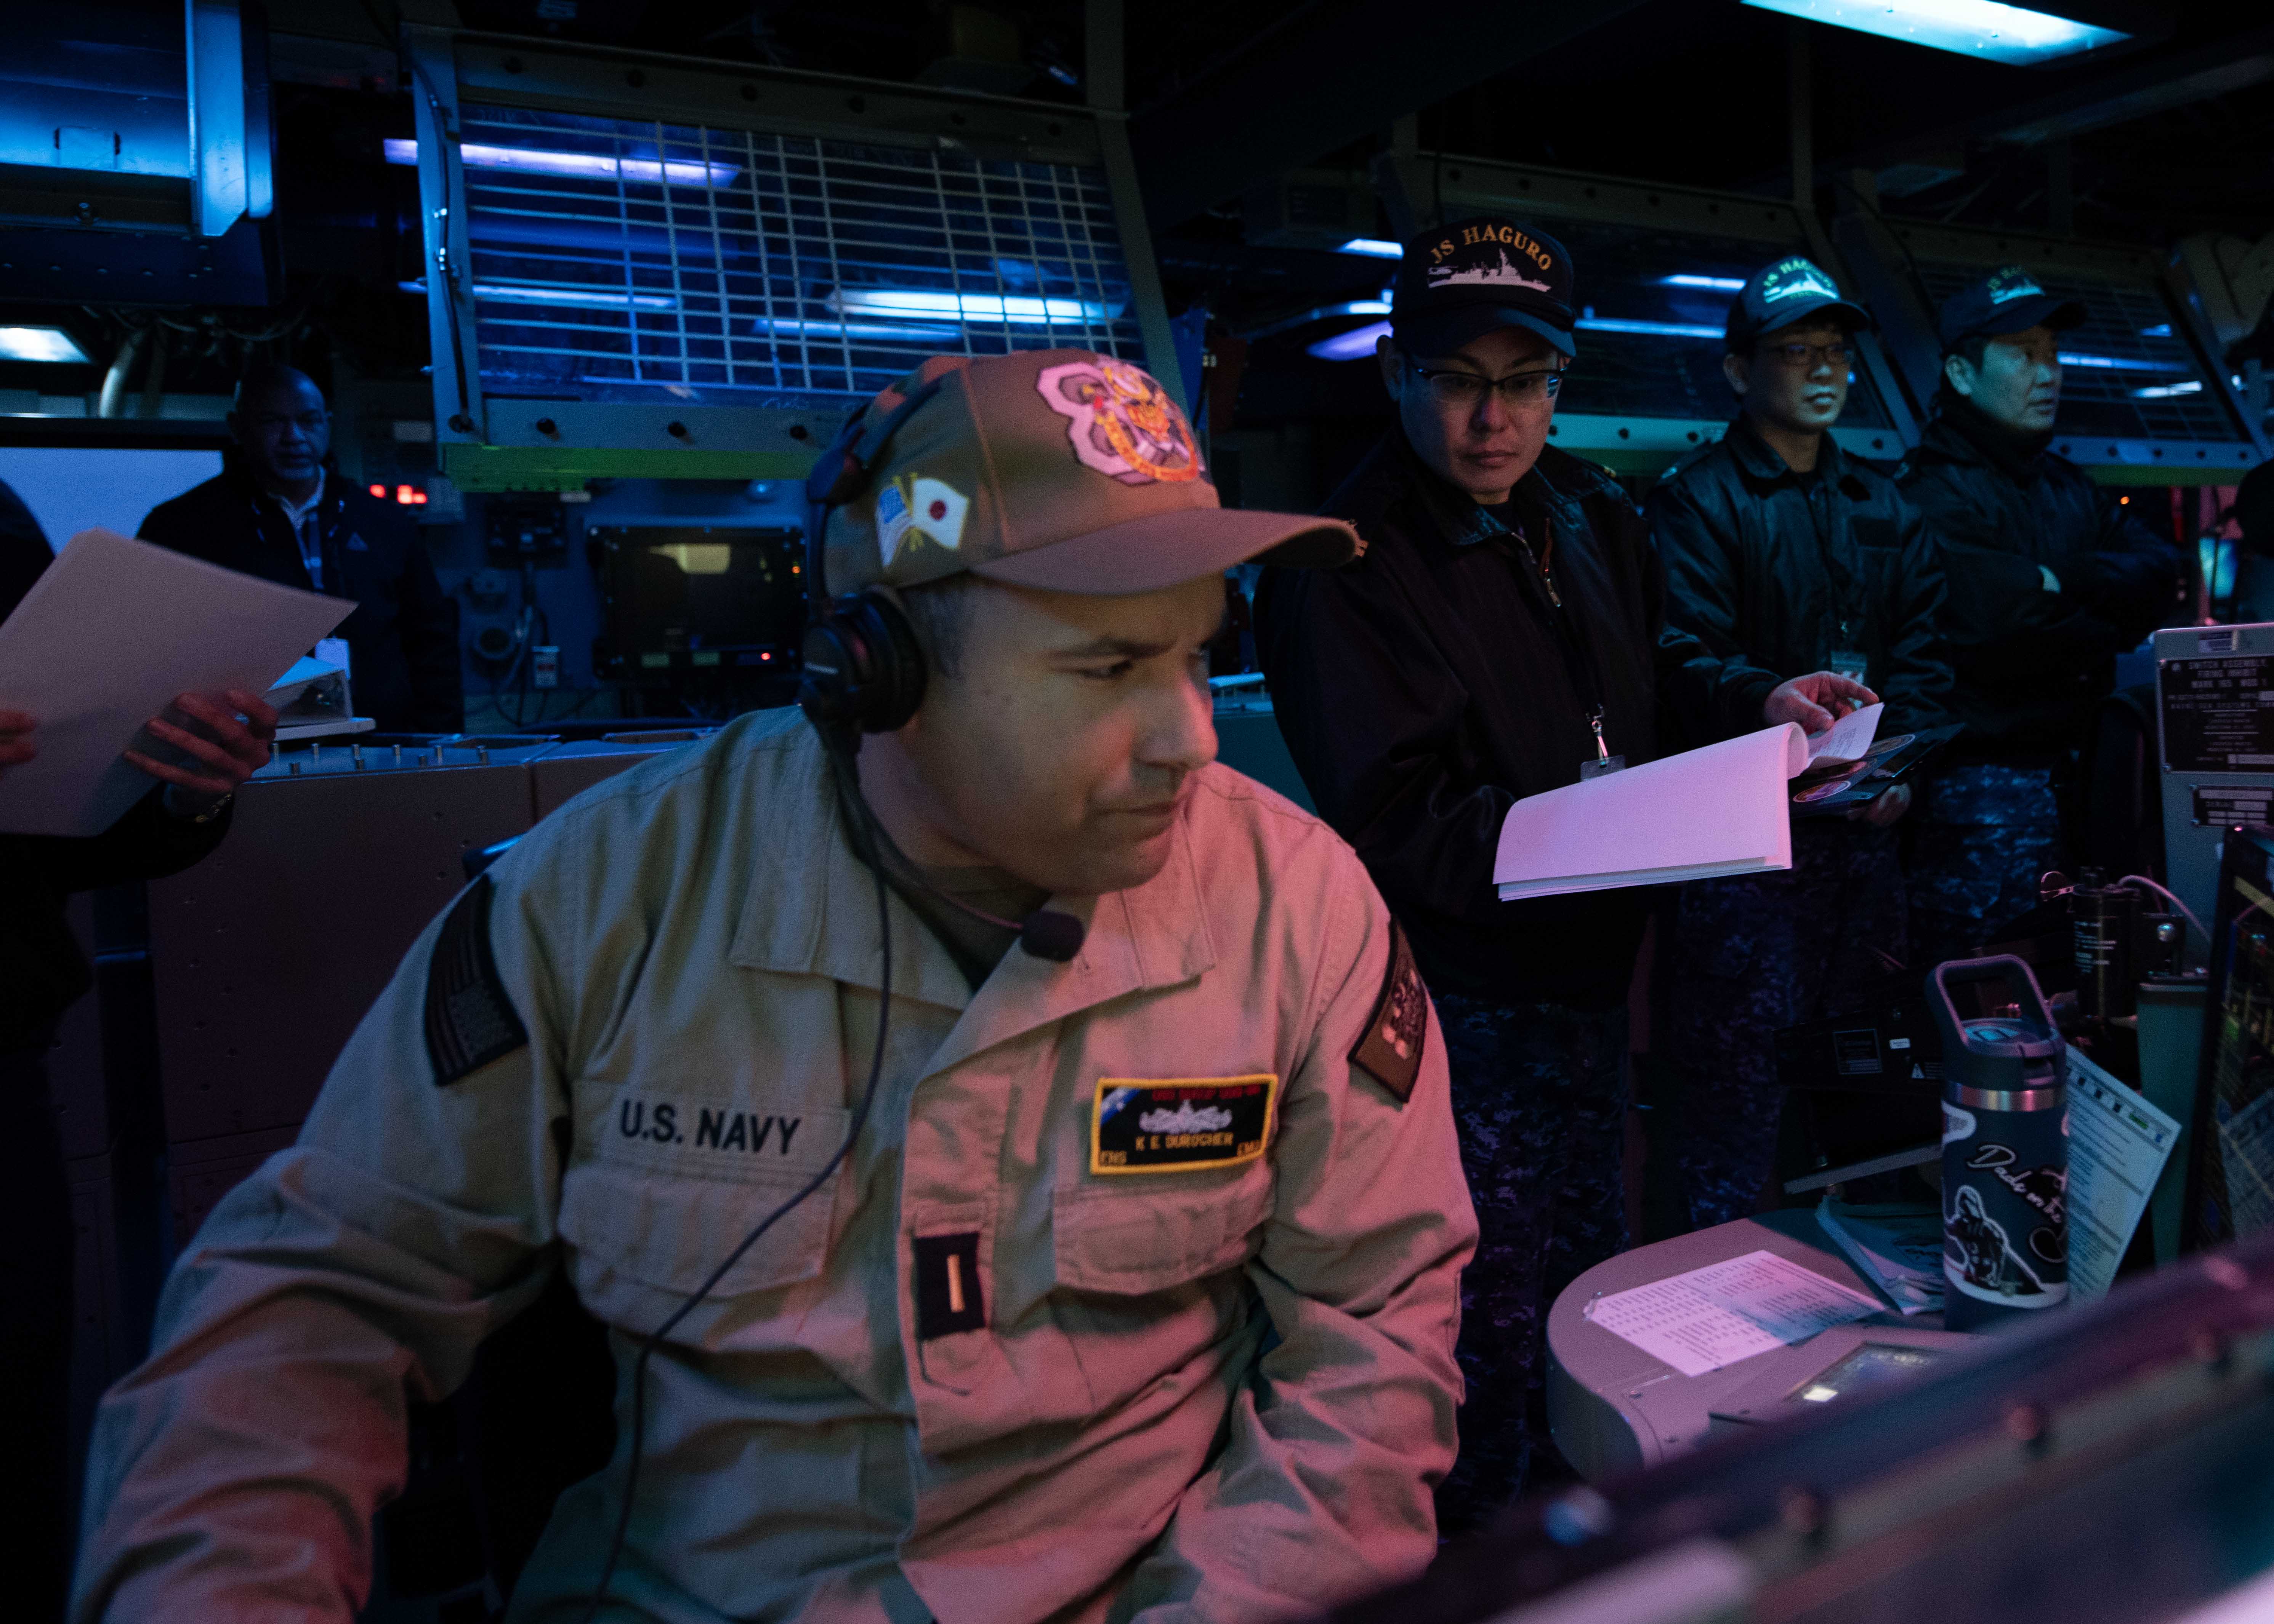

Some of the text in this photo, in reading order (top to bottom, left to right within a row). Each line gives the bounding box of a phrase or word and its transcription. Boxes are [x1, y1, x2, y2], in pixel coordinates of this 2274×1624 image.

[1430, 223, 1552, 271] JS HAGURO
[621, 1099, 802, 1155] U.S. NAVY
[1135, 1132, 1235, 1152] K E DUROCHER
